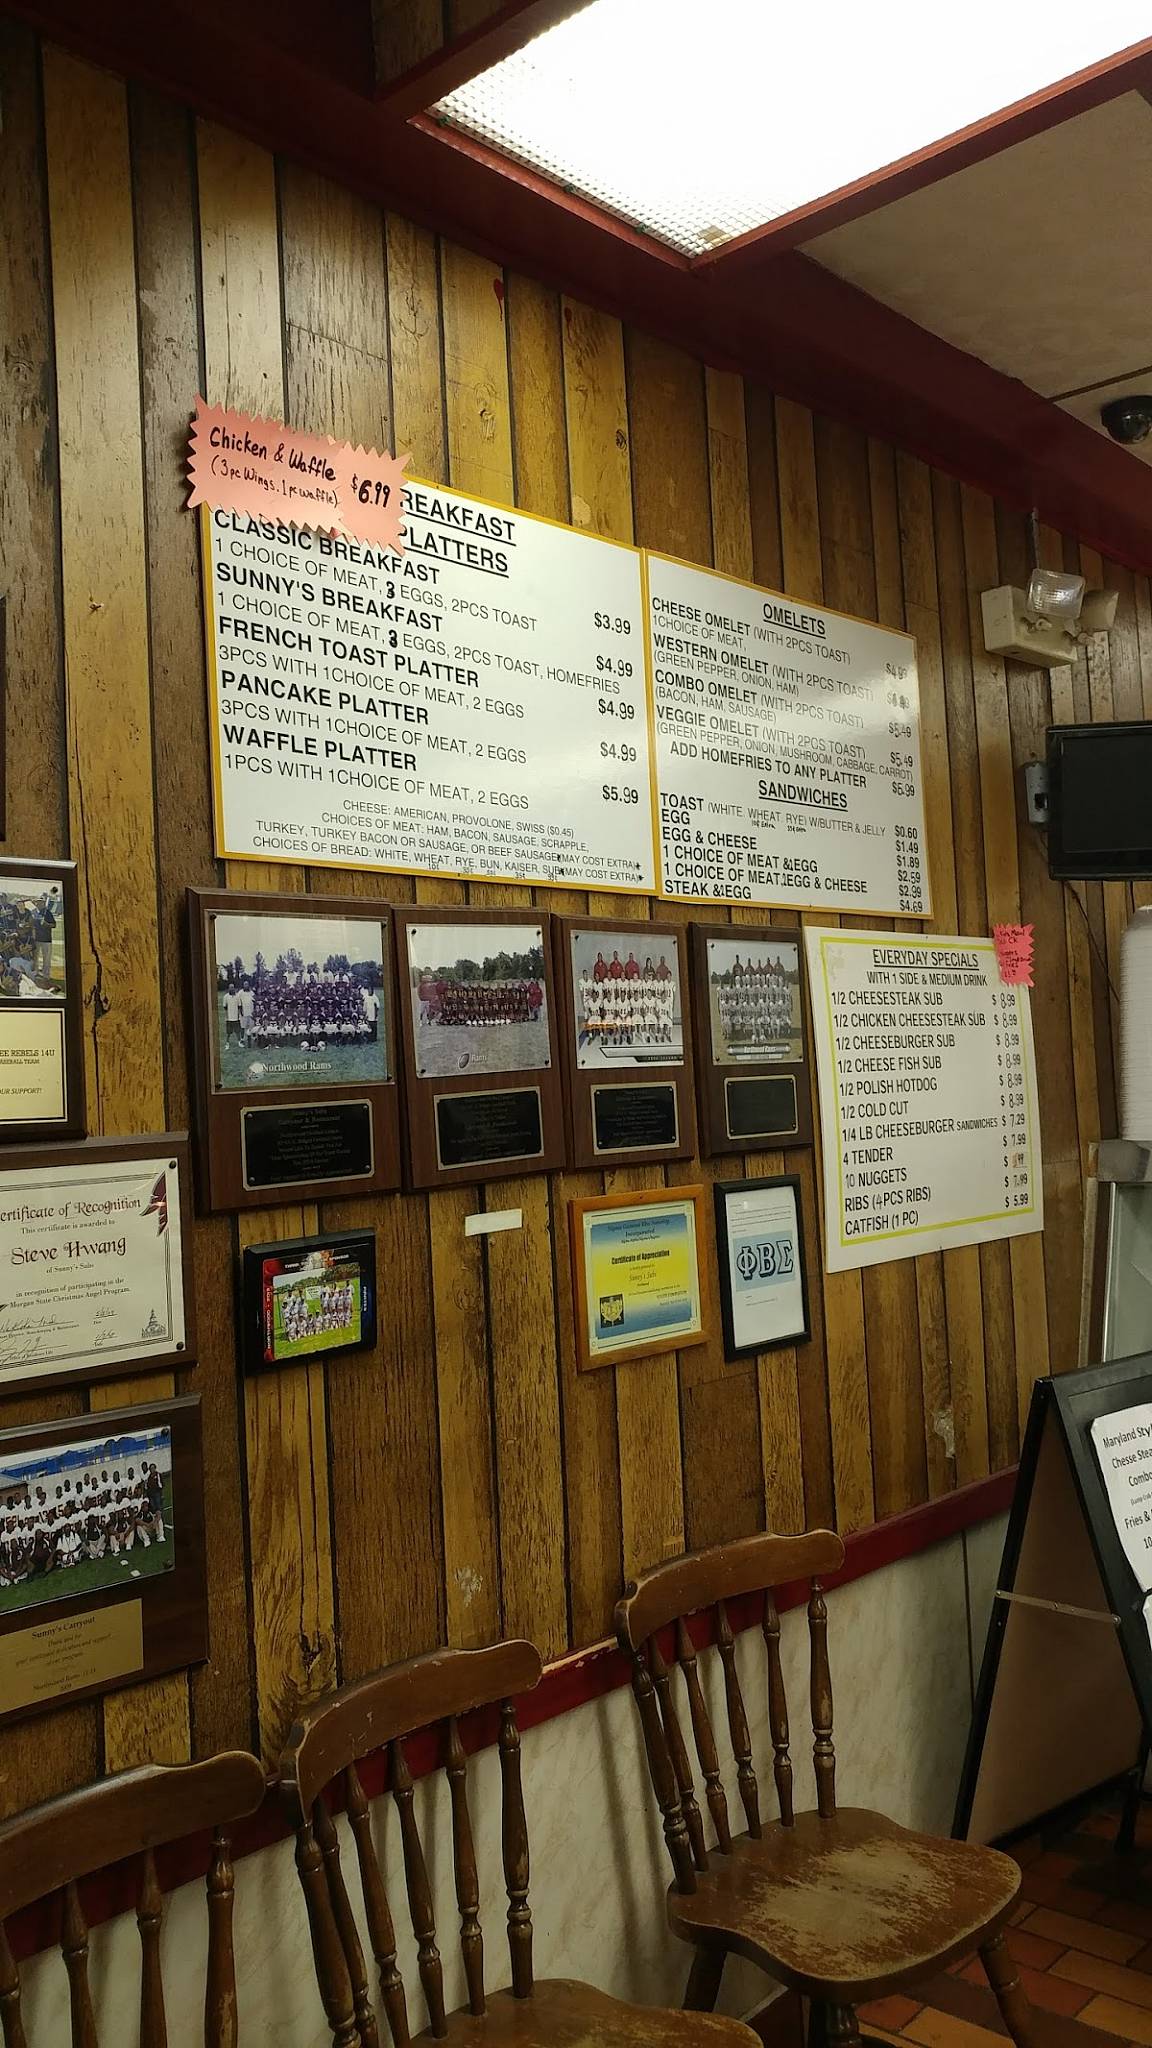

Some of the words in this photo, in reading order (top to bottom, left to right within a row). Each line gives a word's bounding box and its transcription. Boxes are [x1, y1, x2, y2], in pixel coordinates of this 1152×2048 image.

[209, 426, 267, 461] Chicken
[273, 442, 285, 464] &
[288, 448, 336, 481] Waffle
[350, 473, 391, 508] $6.99
[399, 487, 515, 540] REAKFAST
[213, 505, 312, 552] CLASSIC
[317, 534, 441, 586] BREAKFAST
[215, 537, 222, 552] 1
[230, 540, 300, 572] CHOICE
[304, 559, 328, 577] OF
[451, 598, 488, 620] 2PCS
[491, 608, 537, 631] TOAST
[216, 561, 315, 602] SUNNY'S
[321, 587, 443, 632] BREAKFAST
[593, 611, 631, 635] $3.99
[651, 596, 702, 623] CHEESE
[704, 612, 750, 636] OMELET
[785, 635, 812, 654] 2PCS
[762, 602, 825, 635] OMELETS
[219, 615, 312, 653] FRENCH
[318, 636, 388, 668] TOAST
[394, 653, 479, 688] PLATTER
[595, 654, 633, 677] $4.99
[221, 669, 332, 708] PANCAKE
[338, 691, 428, 725] PLATTER
[598, 697, 634, 720] $4.99
[655, 703, 706, 727] VEGGIE
[709, 715, 759, 738] OMELET
[797, 734, 826, 751] 2PCS
[222, 723, 318, 756] WAFFLE
[324, 740, 416, 771] PLATTER
[599, 741, 637, 762] $4.99
[670, 740, 698, 758] ADD
[701, 745, 772, 772] HOMEFRIES
[774, 759, 791, 775] TO
[793, 763, 816, 779] ANY
[819, 767, 866, 788] PLATTER
[224, 753, 272, 774] 1PCS
[276, 760, 322, 781] WITH
[404, 779, 425, 794] OF
[477, 790, 486, 804] 2
[489, 791, 529, 809] EGGS
[602, 784, 638, 804] $5.99
[758, 779, 848, 808] SANDWICHES
[661, 807, 690, 825] EGG
[662, 825, 691, 843] EGG
[695, 830, 704, 844] &
[707, 831, 757, 850] CHEESE
[894, 824, 918, 840] $0.60
[895, 839, 919, 854] $1.49
[896, 854, 920, 869] $1.89
[897, 869, 921, 884] $2.59
[898, 884, 922, 899] $2.99
[872, 948, 928, 965] EVERYDAY
[930, 951, 978, 967] SPECIALS
[866, 971, 890, 984] WITH
[891, 972, 897, 984] 1
[898, 971, 919, 985] SIDE
[921, 973, 928, 985] &
[928, 972, 962, 986] MEDIUM
[962, 973, 988, 986] DRINK
[831, 991, 846, 1005] 1/2
[848, 990, 922, 1005] CHEESESTEAK
[922, 991, 943, 1006] SUB
[833, 1013, 849, 1028] 1/2
[850, 1013, 896, 1028] CHICKEN
[898, 1012, 967, 1027] CHEESESTEAK
[967, 1012, 986, 1026] SUB
[835, 1036, 851, 1051] 1/2
[852, 1034, 935, 1050] CHEESEBURGER
[936, 1033, 955, 1048] SUB
[261, 1061, 308, 1072] Northwood
[310, 1060, 332, 1070] Rams
[837, 1059, 853, 1074] 1/2
[854, 1057, 896, 1073] CHEESE
[897, 1055, 920, 1070] FISH
[921, 1055, 942, 1070] SUB
[839, 1081, 854, 1096] 1/2
[856, 1079, 894, 1095] POLISH
[895, 1076, 937, 1093] HOTDOG
[840, 1104, 855, 1119] 1/2
[857, 1101, 887, 1118] COLD
[888, 1100, 909, 1116] CUT
[841, 1127, 856, 1142] 1/4
[858, 1125, 873, 1141] LB
[874, 1118, 955, 1139] CHEESEBURGER
[956, 1116, 998, 1131] SANDWICHES
[842, 1152, 849, 1165] 4
[850, 1146, 893, 1165] TENDER
[858, 1167, 907, 1187] NUGGETS
[0, 1205, 55, 1222] ertificate
[58, 1201, 72, 1217] of
[74, 1197, 141, 1217] Recognition
[844, 1194, 869, 1212] RIBS
[844, 1214, 889, 1235] CATFISH
[11, 1246, 58, 1265] Steve
[63, 1237, 126, 1258] Hwang
[1102, 1428, 1137, 1448] Maryland
[1136, 1423, 1152, 1437] Styl
[1112, 1451, 1137, 1469] Chesse
[1137, 1447, 1152, 1460] Stea
[1124, 1515, 1144, 1530] Fries
